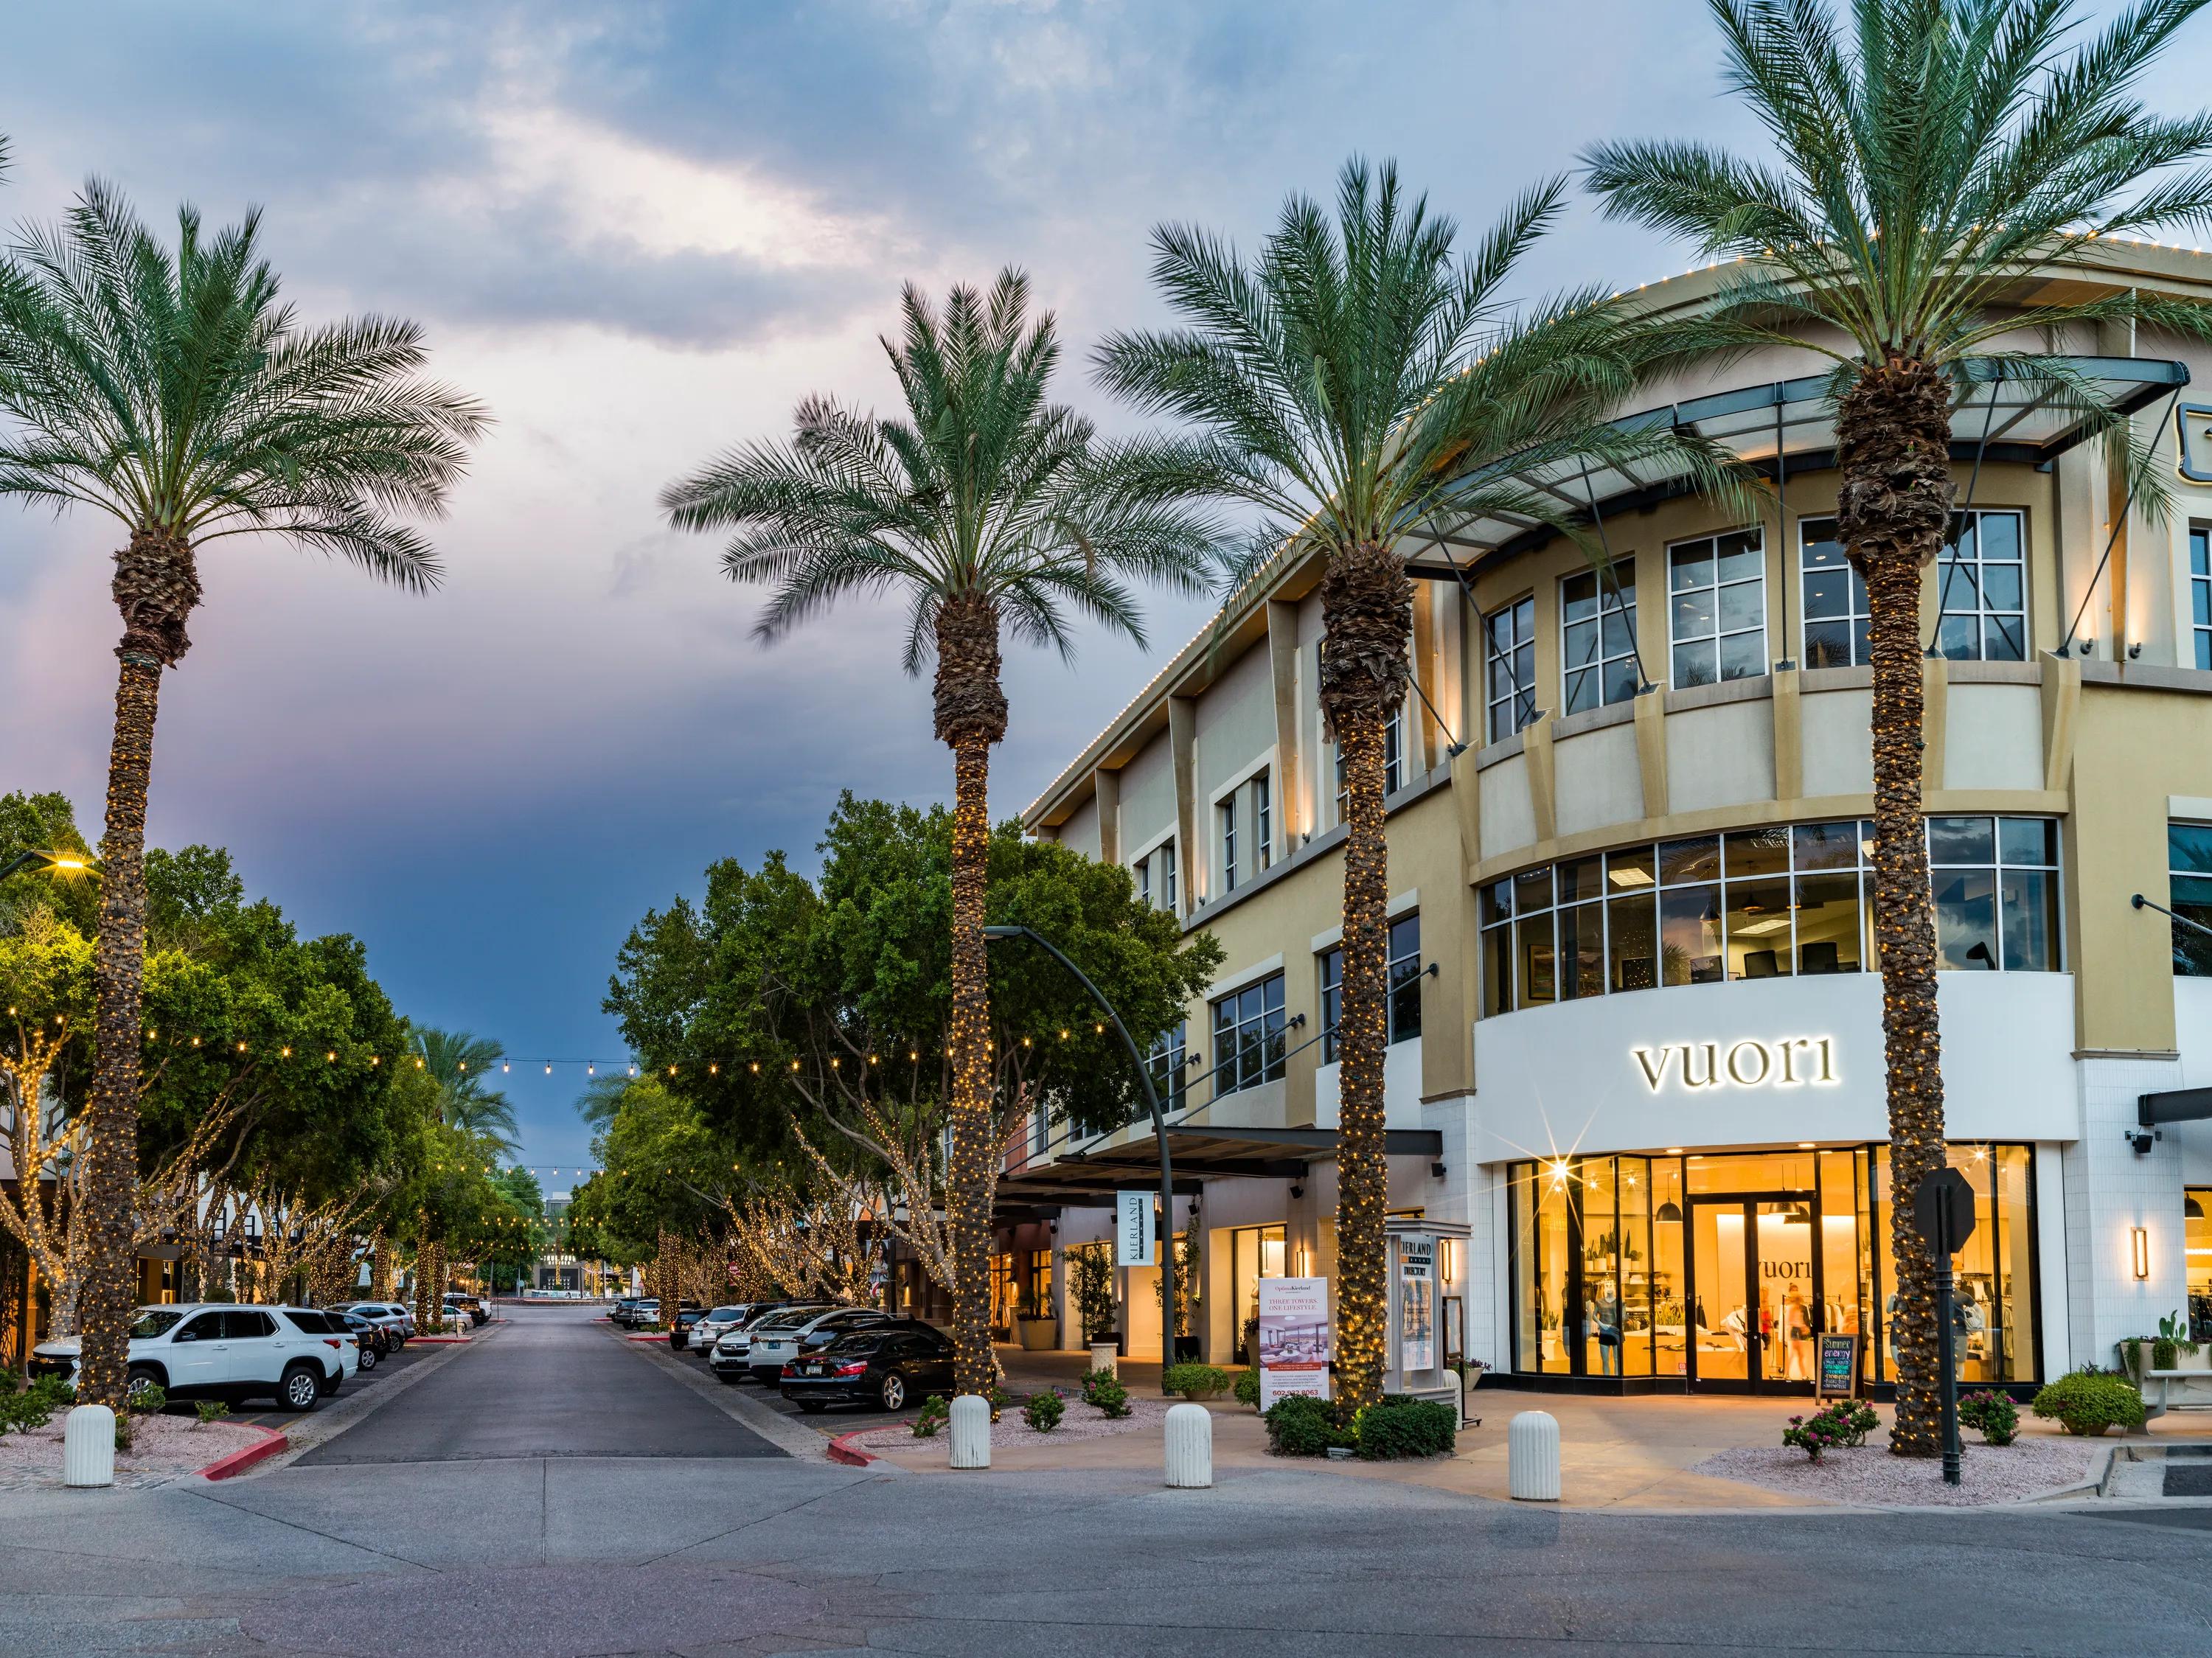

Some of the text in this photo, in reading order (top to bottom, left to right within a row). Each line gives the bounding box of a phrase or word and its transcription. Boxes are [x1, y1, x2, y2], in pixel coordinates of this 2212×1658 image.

[1630, 1038, 1835, 1091] vuori
[1130, 1197, 1138, 1260] KIERLAND
[1759, 1261, 1812, 1278] uori
